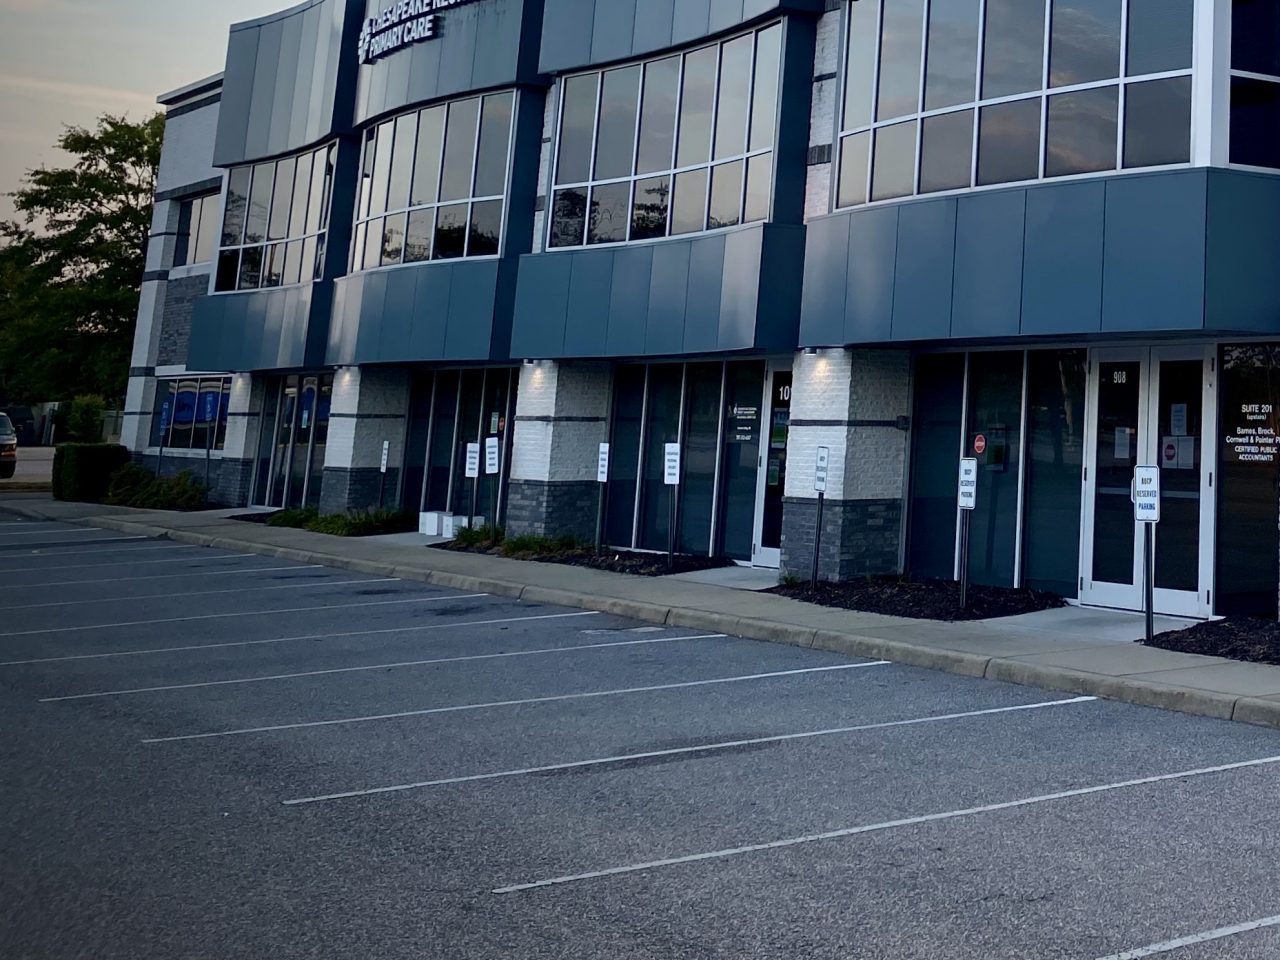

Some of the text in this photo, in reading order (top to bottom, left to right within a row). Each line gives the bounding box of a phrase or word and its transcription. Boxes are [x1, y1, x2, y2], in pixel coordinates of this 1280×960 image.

[403, 14, 435, 43] CARE
[1113, 371, 1127, 384] 908
[779, 385, 792, 401] 10
[1241, 404, 1273, 413] SUITE 201
[1138, 502, 1156, 511] PARKING
